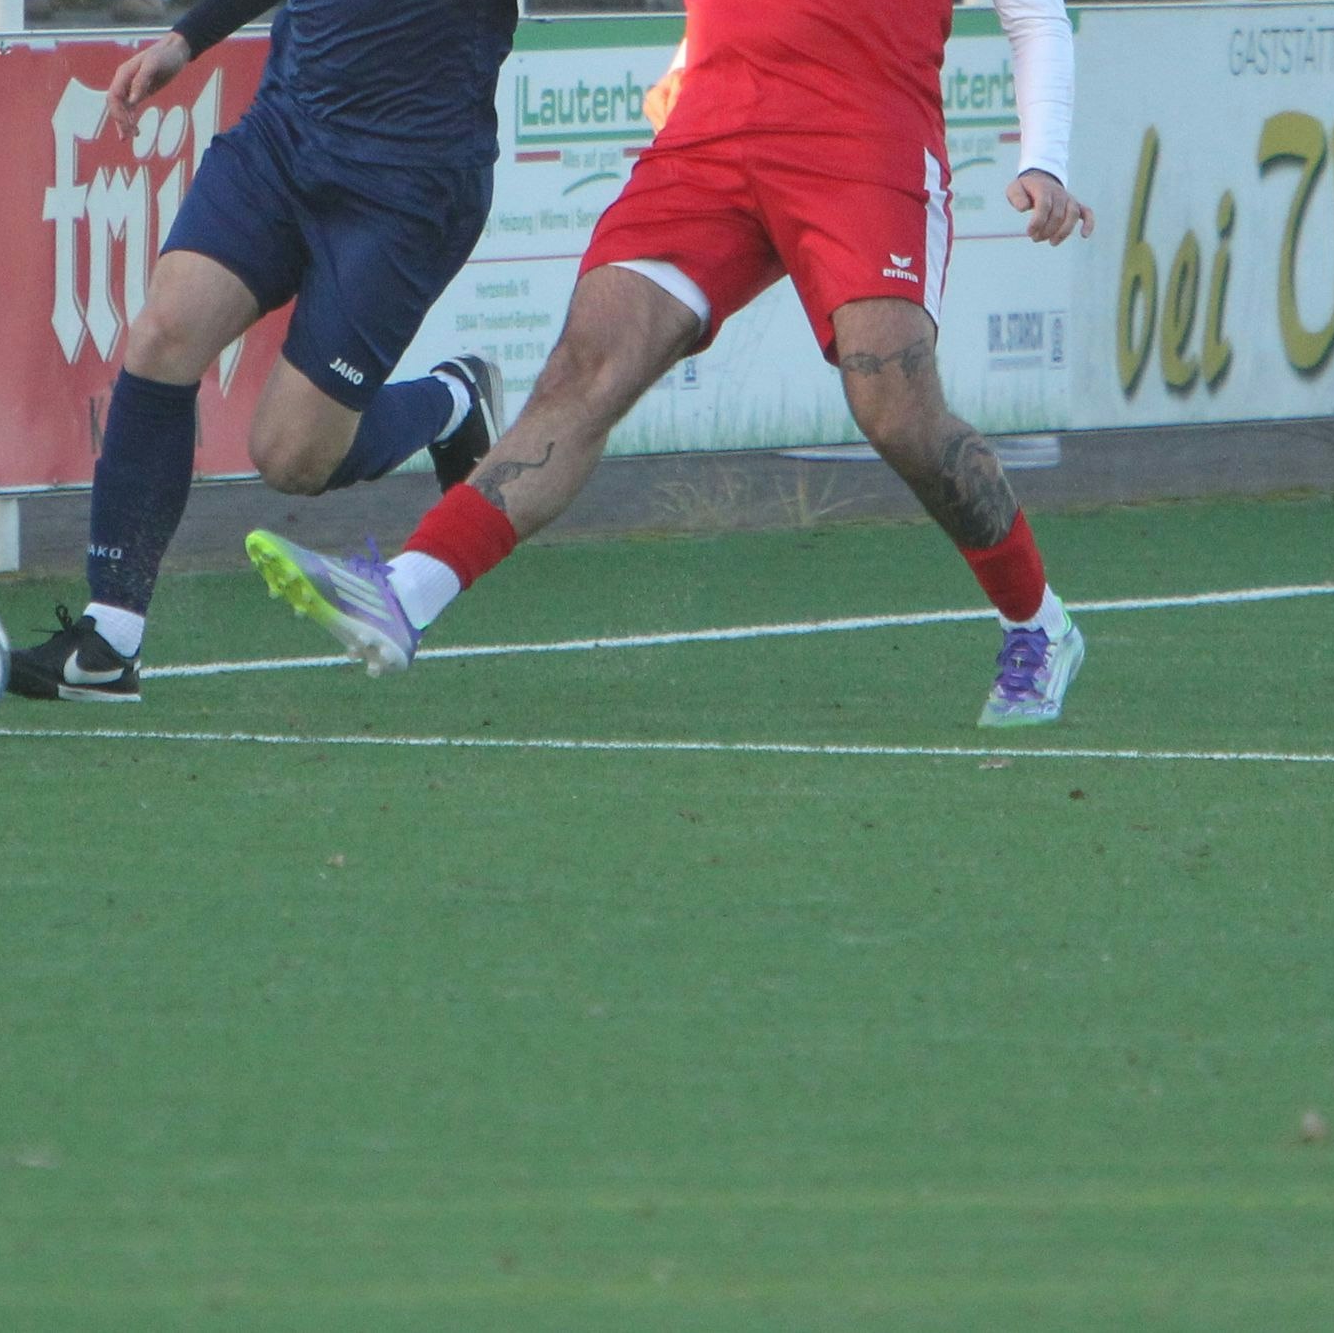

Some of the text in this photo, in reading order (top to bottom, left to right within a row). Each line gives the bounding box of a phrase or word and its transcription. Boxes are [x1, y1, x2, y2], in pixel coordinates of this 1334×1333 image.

[522, 71, 652, 126] Lauterb
[882, 268, 919, 284] erima
[1116, 123, 1234, 402] bei
[329, 357, 364, 385] JAKO
